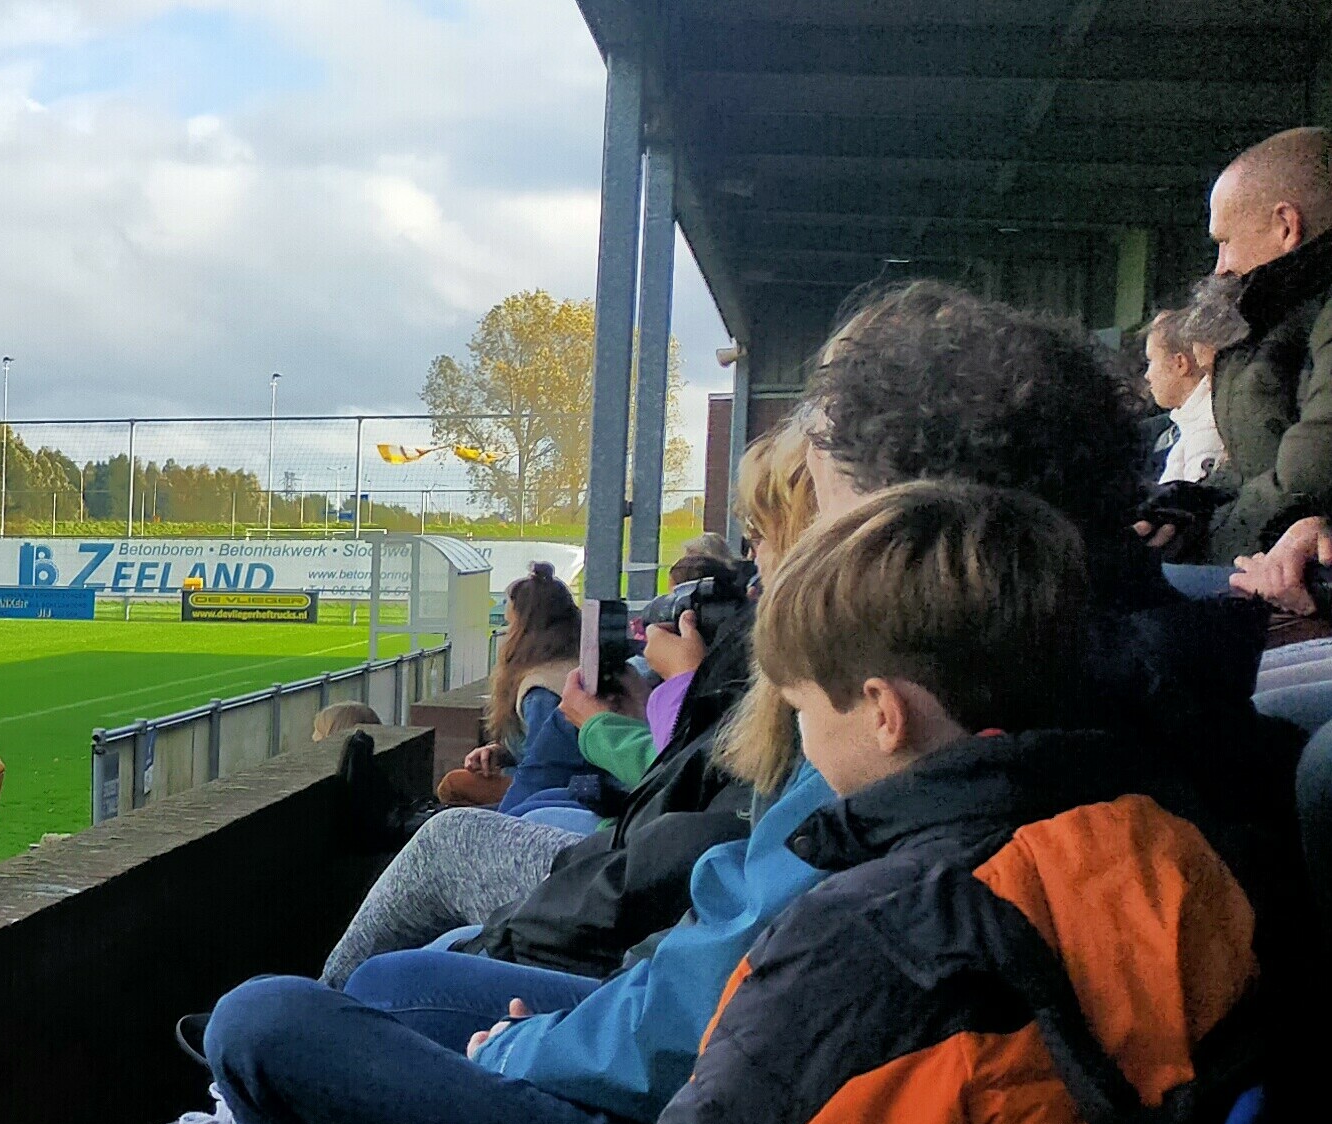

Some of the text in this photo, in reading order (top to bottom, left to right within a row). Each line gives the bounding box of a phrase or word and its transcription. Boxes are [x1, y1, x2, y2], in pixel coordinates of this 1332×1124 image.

[118, 542, 204, 556] Betonboren
[218, 543, 327, 557] Betonhakwerk
[69, 542, 275, 593] ZEELAND
[194, 596, 305, 605] DE VLIEGER
[191, 609, 308, 620] www.devliegerheftrucks.nl
